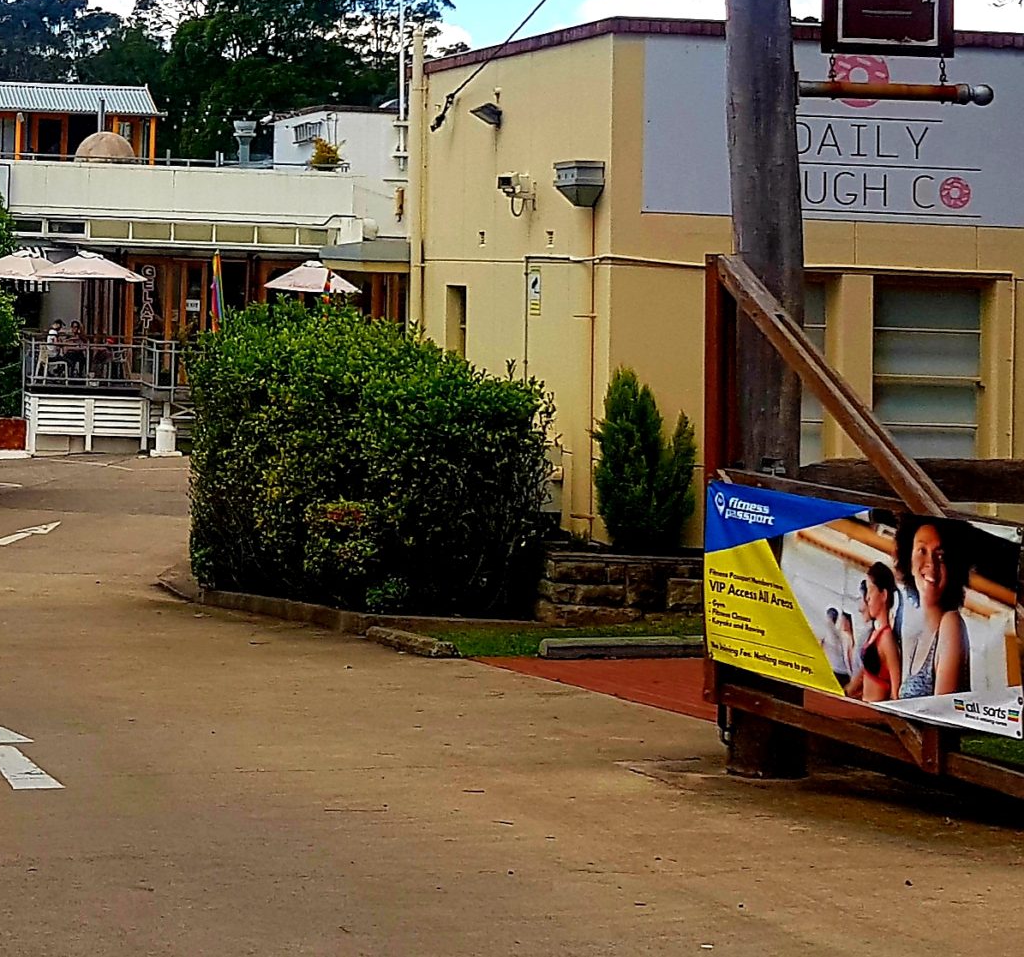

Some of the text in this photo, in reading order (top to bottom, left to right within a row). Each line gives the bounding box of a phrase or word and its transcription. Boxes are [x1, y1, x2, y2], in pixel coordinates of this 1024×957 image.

[804, 171, 887, 207] UGH
[729, 497, 770, 514] fitness
[725, 508, 775, 525] passport
[709, 580, 794, 609] VIP Access All Areas
[966, 702, 1006, 719] all sorts
